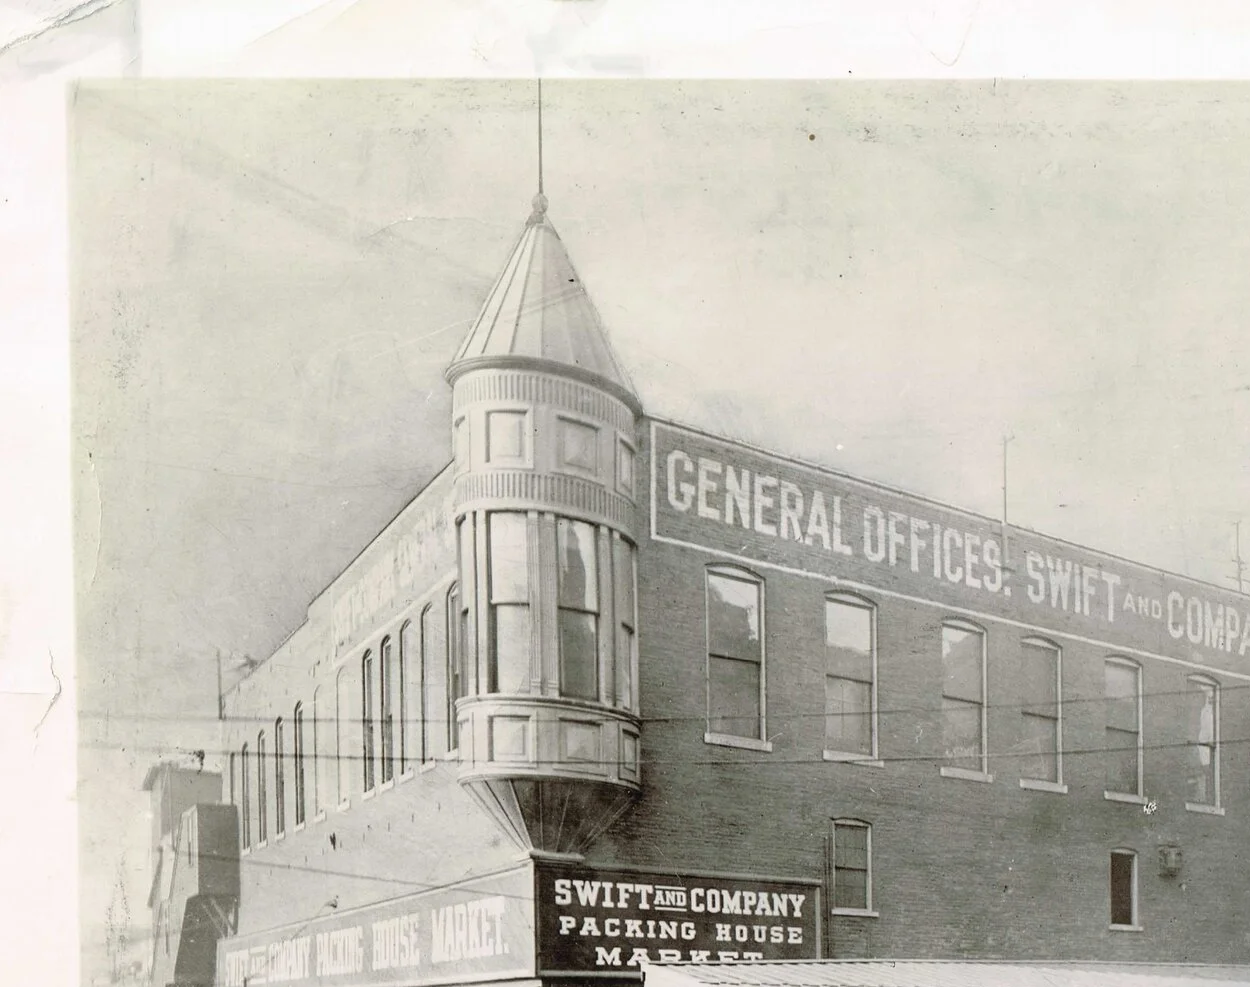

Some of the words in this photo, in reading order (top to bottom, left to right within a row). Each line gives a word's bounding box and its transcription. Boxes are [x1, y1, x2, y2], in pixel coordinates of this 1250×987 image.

[667, 449, 853, 556] GENERAL
[1026, 554, 1122, 622] SWIFT
[1123, 592, 1162, 620] AND
[554, 879, 654, 911] SWIFT
[655, 890, 687, 907] AND
[690, 888, 806, 918] COMPANY
[268, 936, 310, 982] COMPANY
[316, 926, 364, 977] PACKING
[372, 912, 420, 971] HOUSE
[431, 896, 510, 963] MARKET.
[559, 916, 697, 940] PACKING
[716, 923, 803, 944] HOUSE
